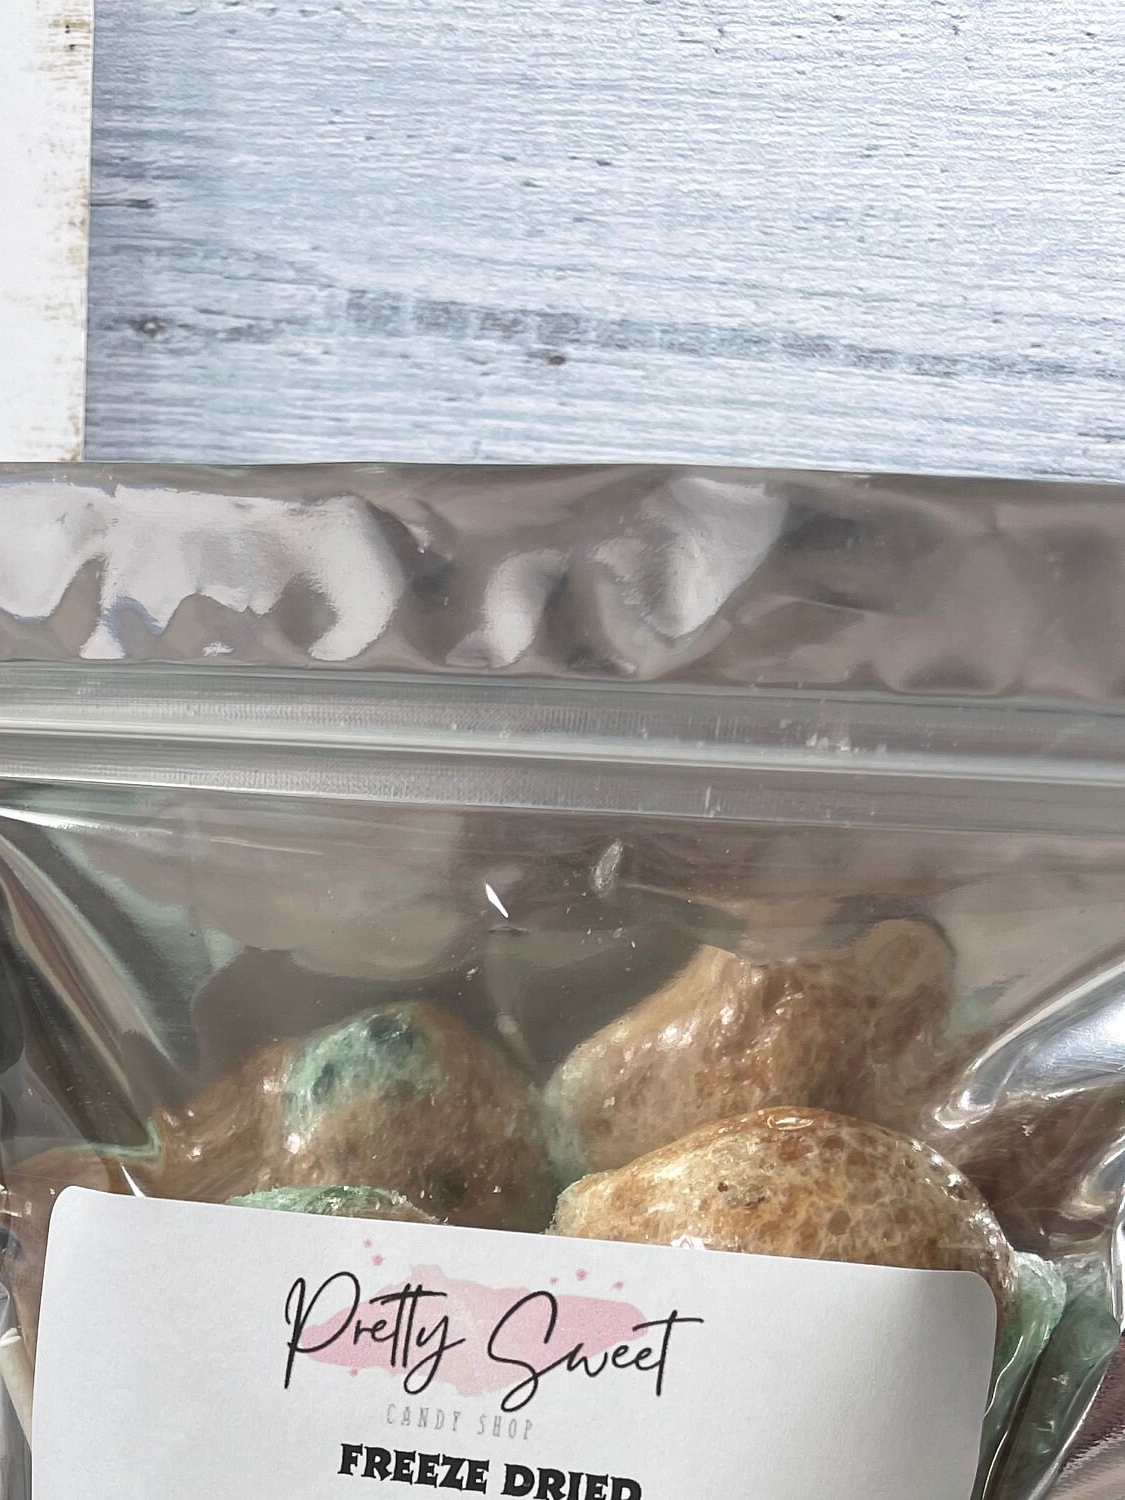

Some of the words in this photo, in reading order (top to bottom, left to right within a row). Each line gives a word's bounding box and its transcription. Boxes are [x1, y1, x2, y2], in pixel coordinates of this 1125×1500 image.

[284, 1271, 466, 1395] Pretty
[487, 1290, 704, 1413] Sweet
[386, 1403, 462, 1433] CANDY
[476, 1413, 533, 1441] SHOP
[336, 1442, 491, 1495] FREEZE
